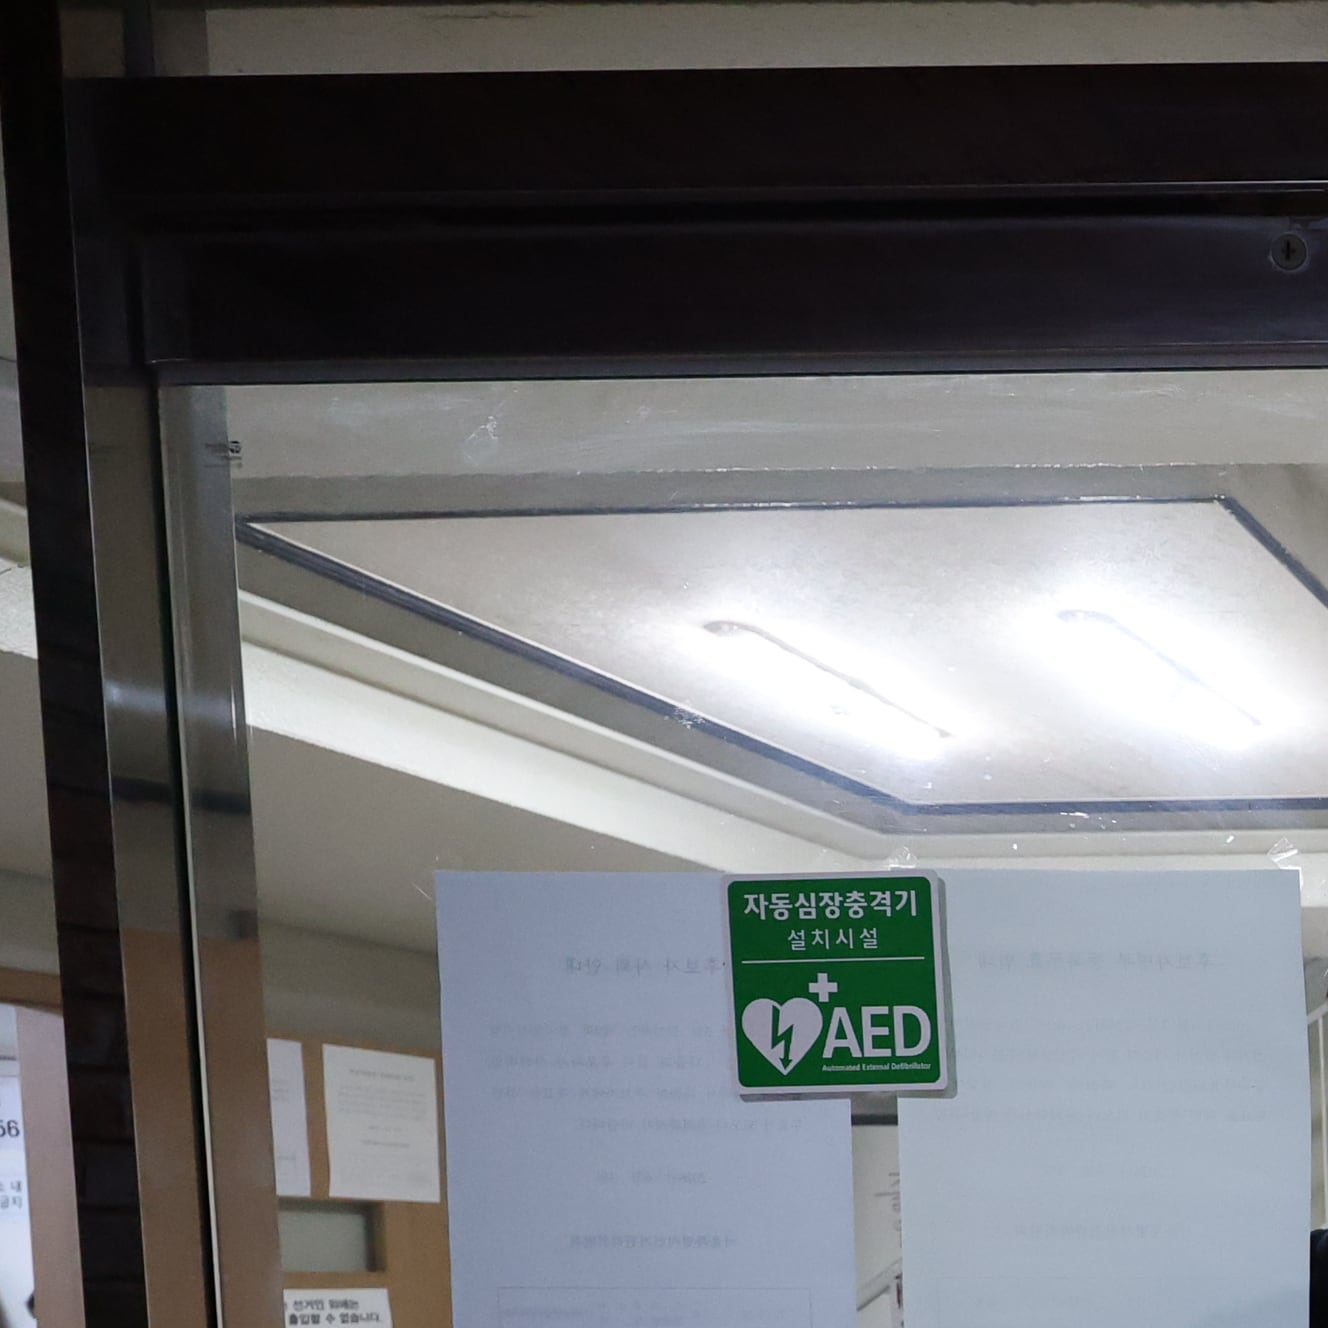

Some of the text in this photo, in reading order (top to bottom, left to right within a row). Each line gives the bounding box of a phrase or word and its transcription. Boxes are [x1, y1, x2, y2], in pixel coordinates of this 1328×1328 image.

[744, 890, 917, 920] 자동심장충격기
[788, 927, 880, 951] 설치시설
[822, 1005, 932, 1059] AED
[822, 1064, 860, 1072] Automated
